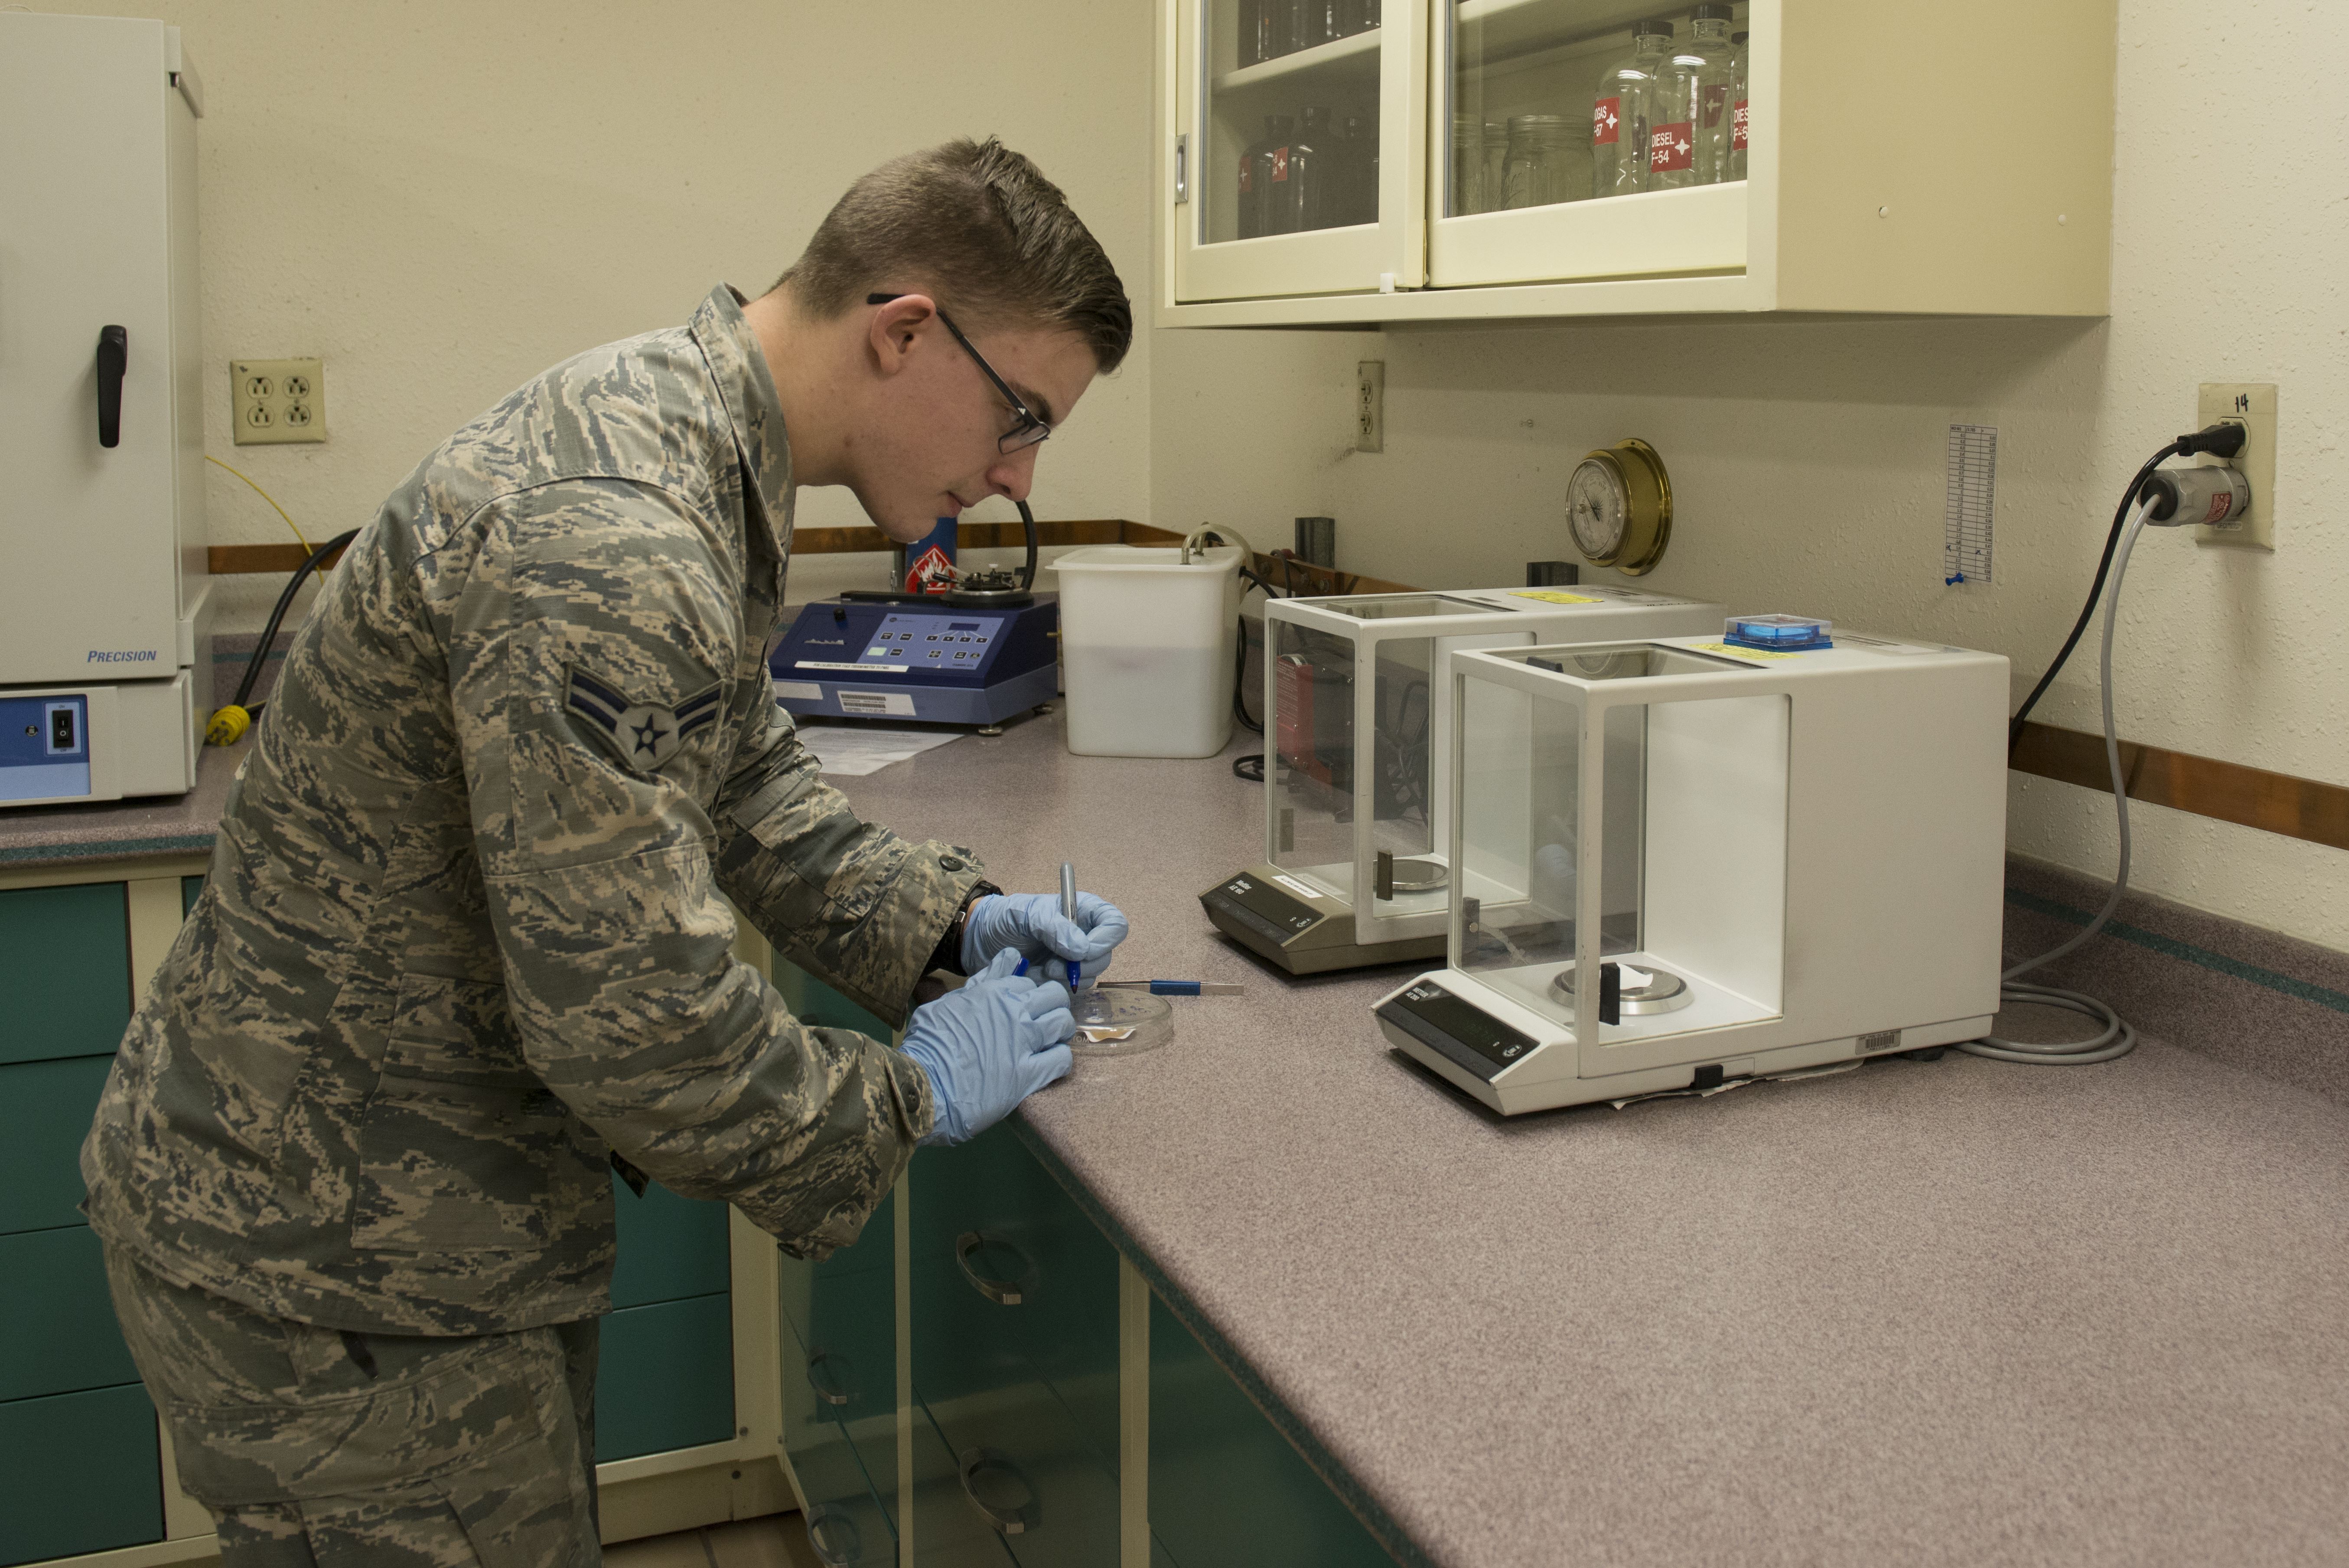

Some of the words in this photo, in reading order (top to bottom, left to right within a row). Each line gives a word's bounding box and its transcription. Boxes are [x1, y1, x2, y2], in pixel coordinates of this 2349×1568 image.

[1652, 132, 1675, 147] DIESEL
[1652, 150, 1669, 165] F-54
[2235, 393, 2249, 413] 14
[88, 650, 157, 662] PRECISION
[1235, 880, 1252, 890] Mettler
[1412, 987, 1429, 998] METTLER
